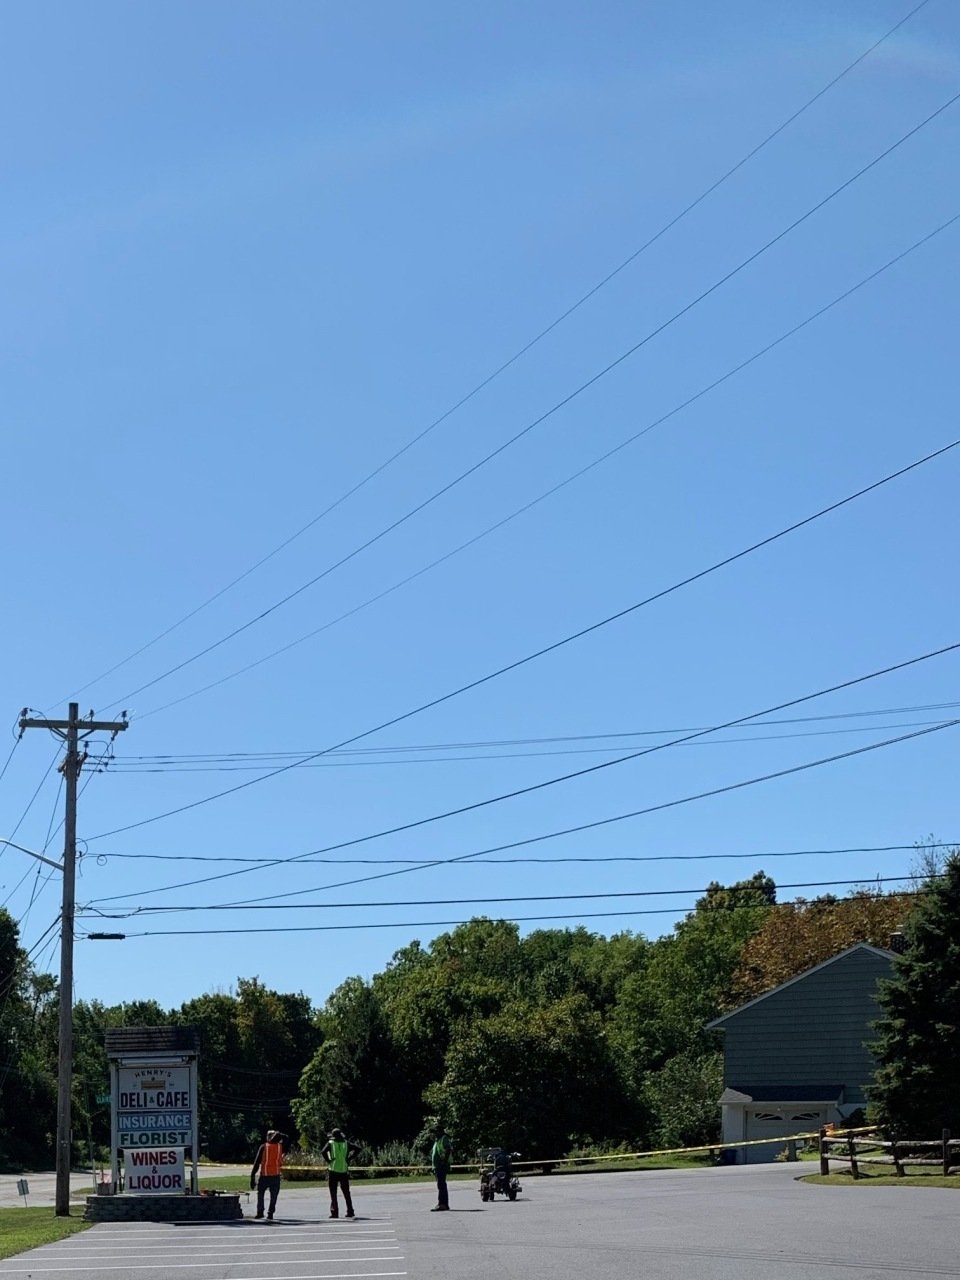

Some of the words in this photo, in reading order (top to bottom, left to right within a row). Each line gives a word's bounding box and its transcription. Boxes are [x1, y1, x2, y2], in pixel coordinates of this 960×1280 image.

[134, 1069, 172, 1078] HENRY'S
[120, 1091, 147, 1108] DELI
[156, 1091, 189, 1108] CAFE
[119, 1114, 190, 1129] INSURANCE
[120, 1131, 188, 1146] FLORIST
[131, 1150, 177, 1166] WINES
[151, 1165, 158, 1174] &
[128, 1174, 182, 1190] LIQUOR
